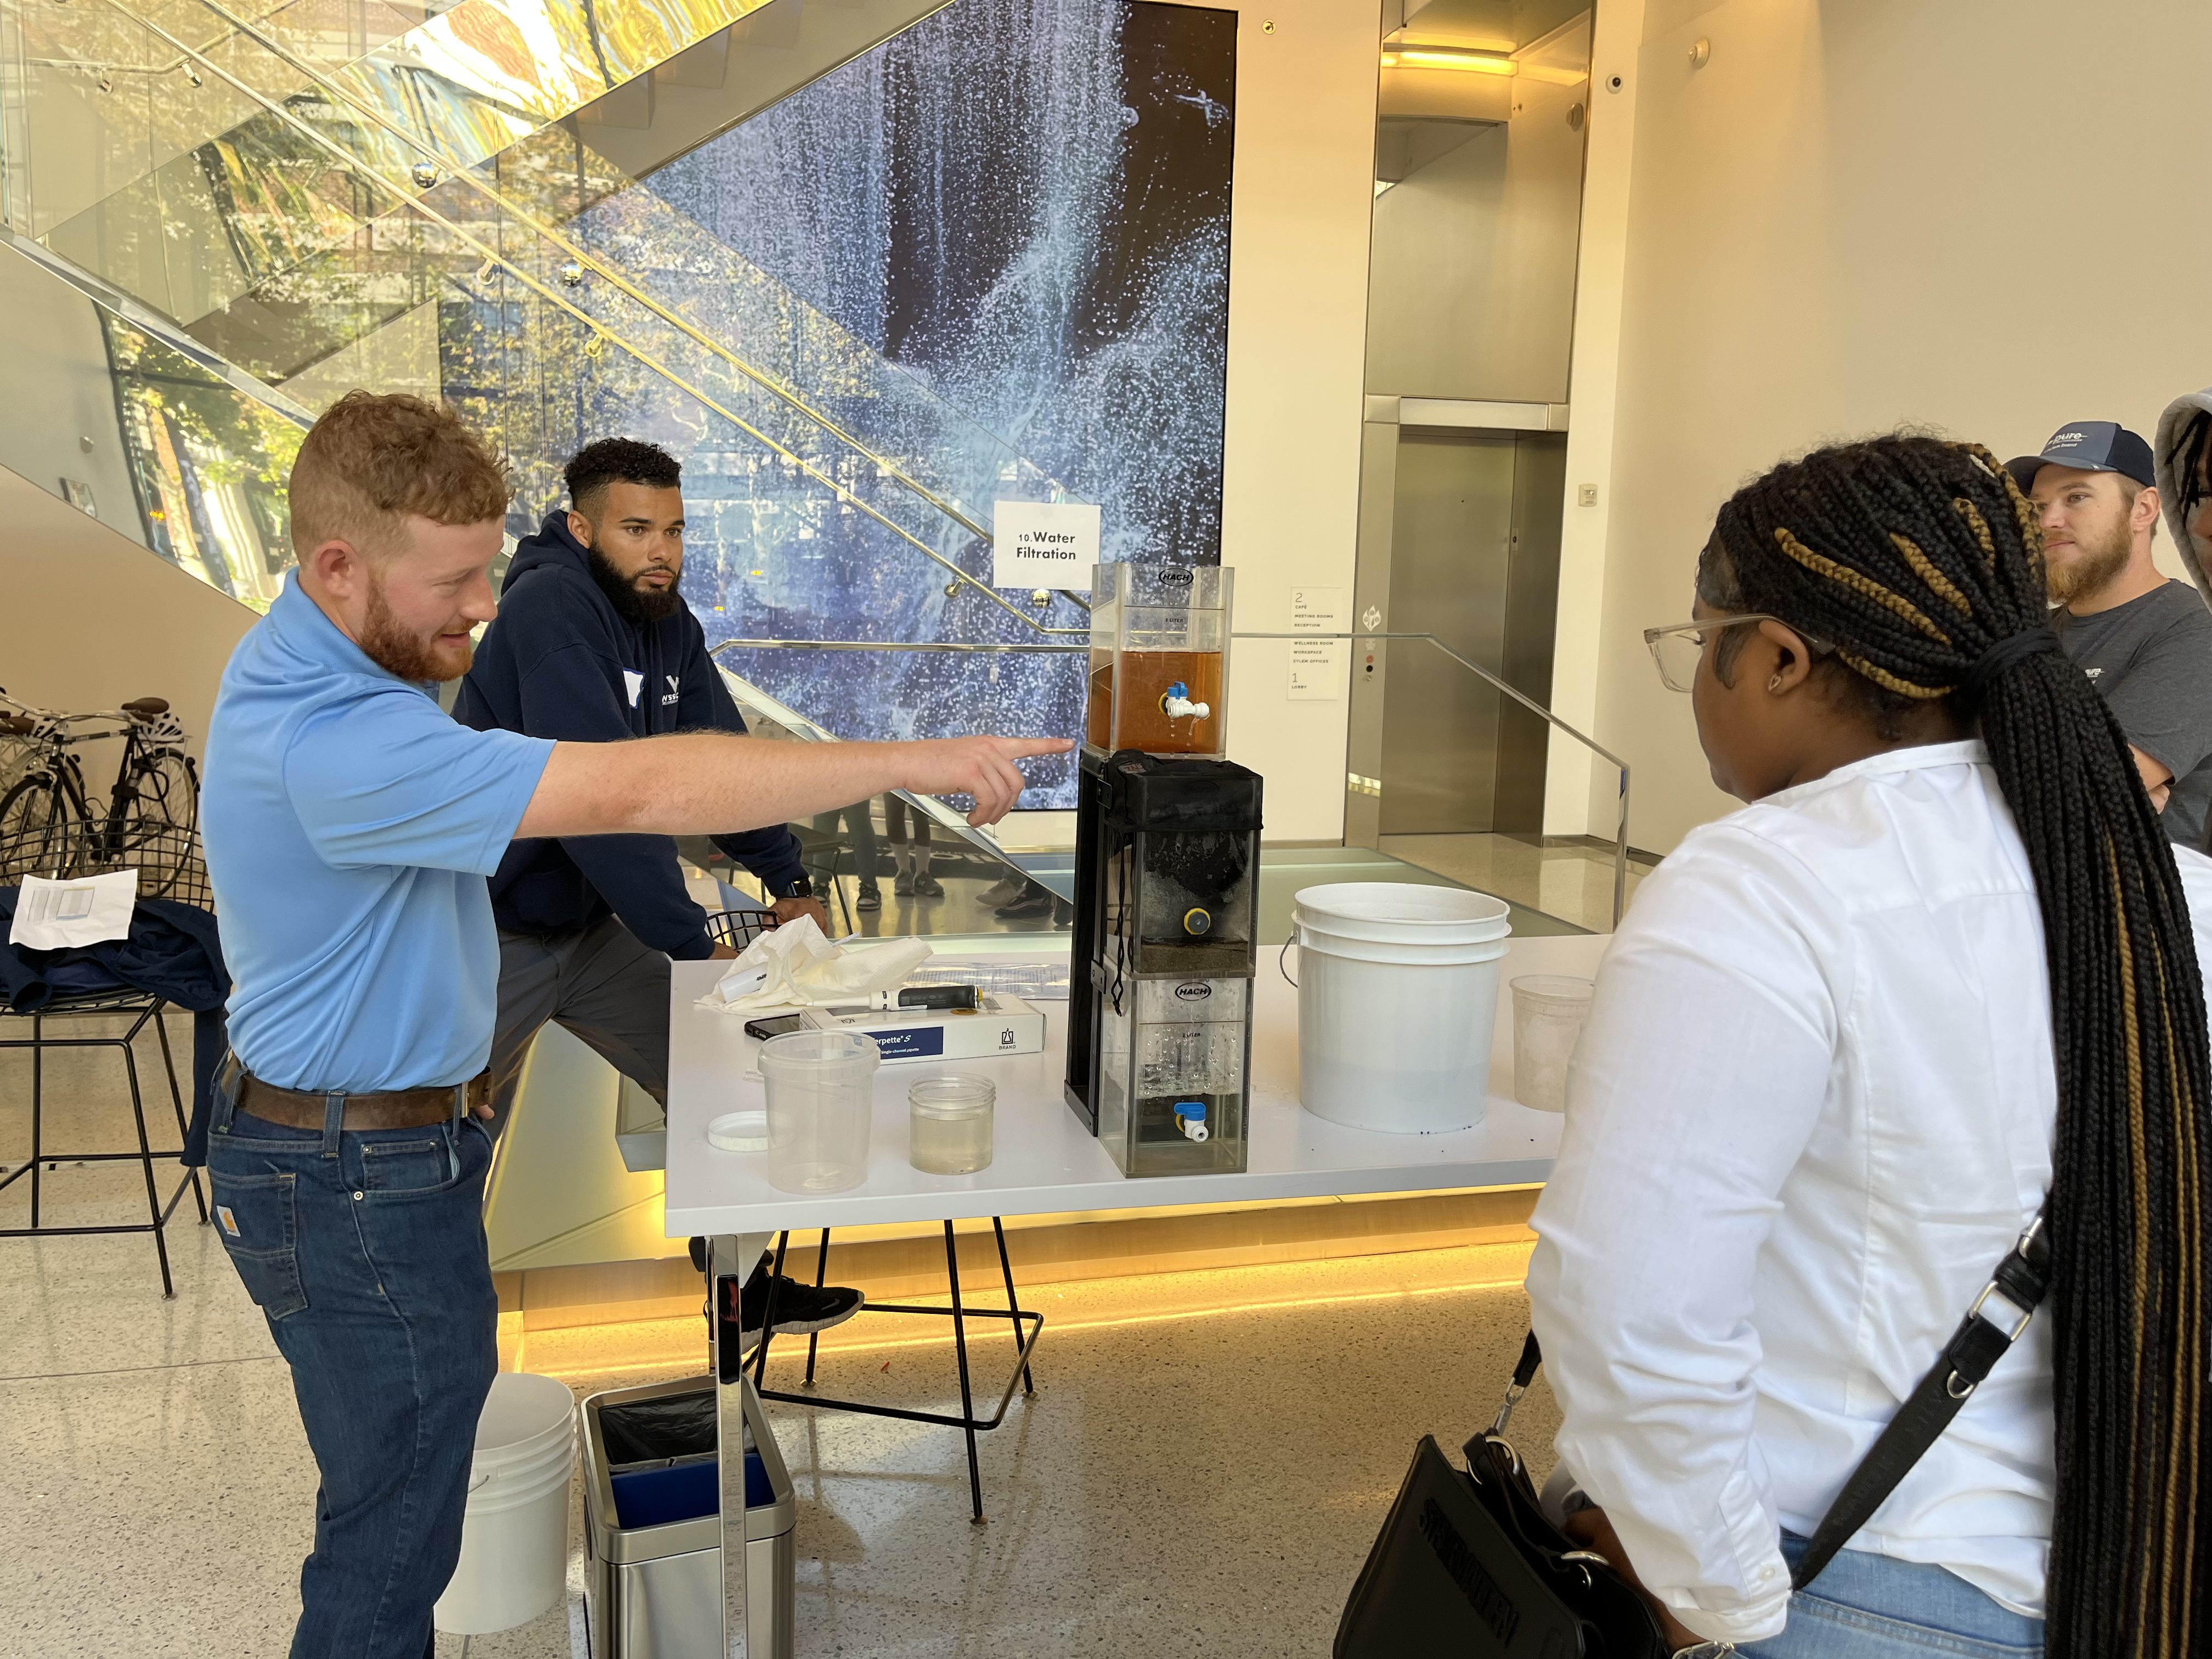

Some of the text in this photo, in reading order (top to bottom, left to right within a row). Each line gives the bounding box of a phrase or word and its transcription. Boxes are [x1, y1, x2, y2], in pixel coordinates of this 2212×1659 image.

[1017, 546, 1076, 560] Filtration
[1295, 592, 1302, 602] 2
[1292, 673, 1298, 682] 1
